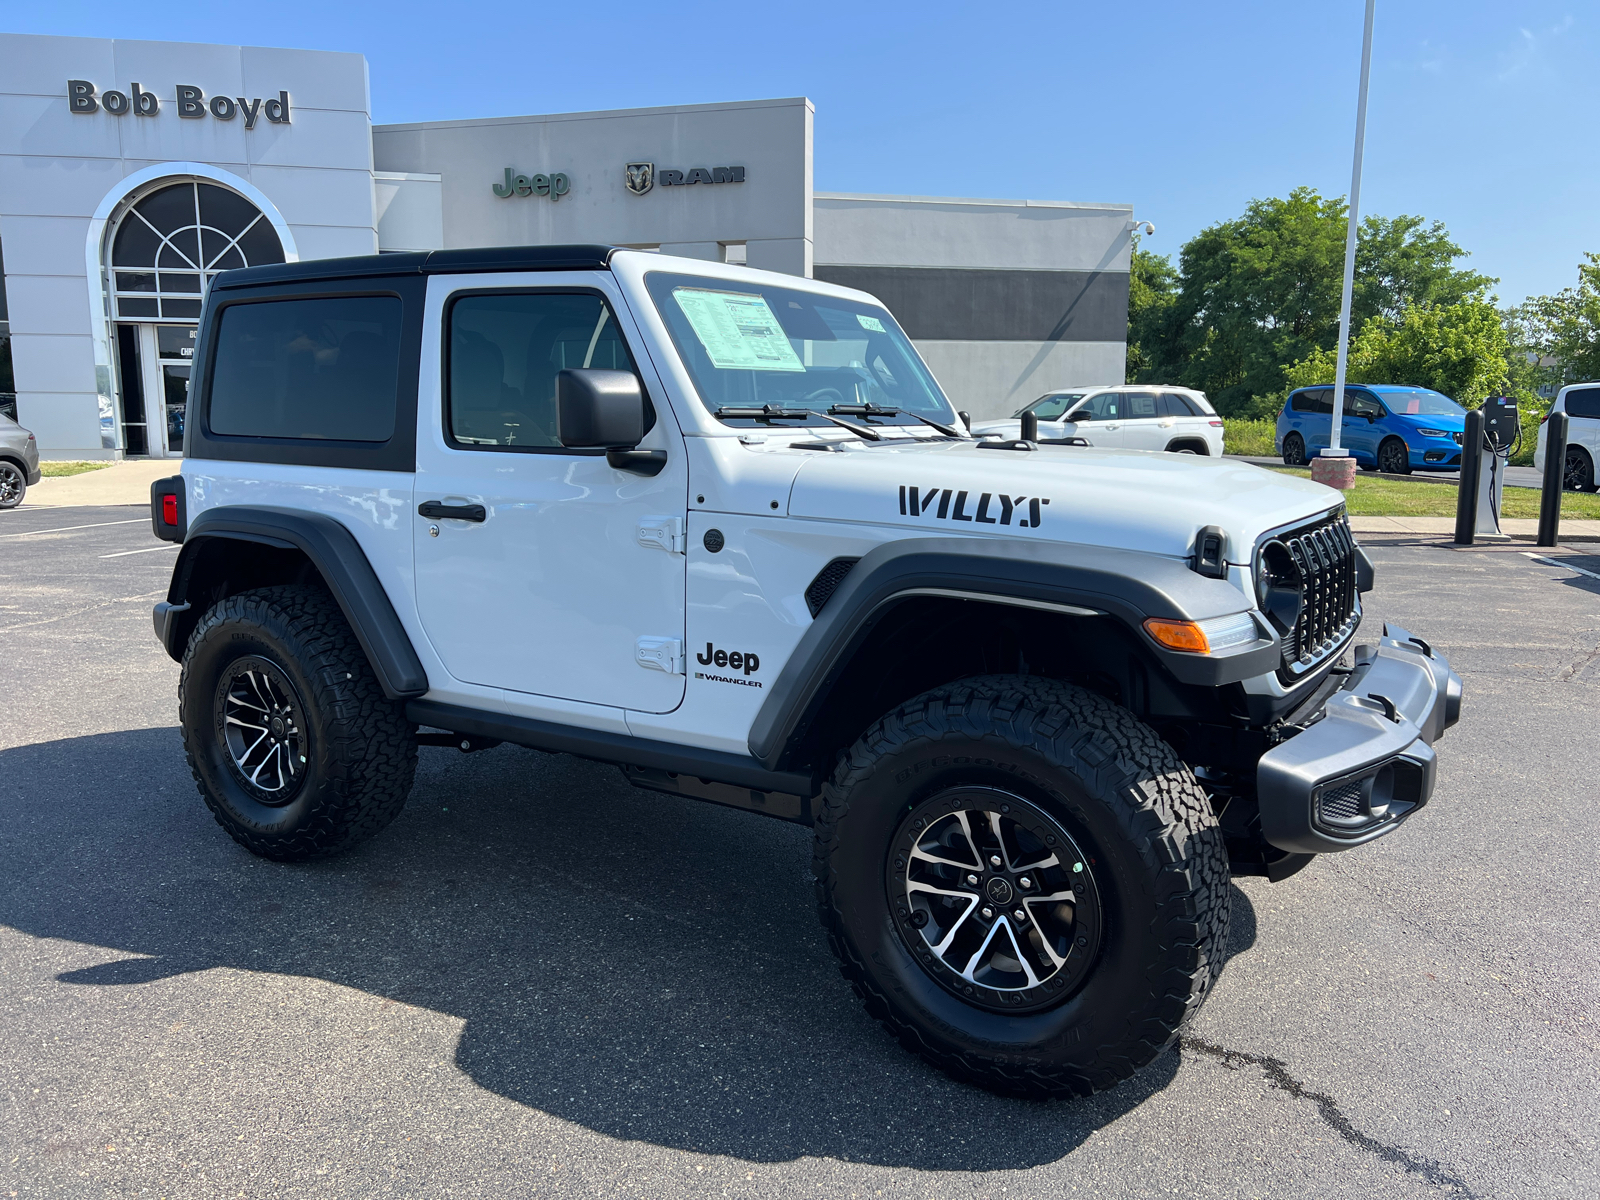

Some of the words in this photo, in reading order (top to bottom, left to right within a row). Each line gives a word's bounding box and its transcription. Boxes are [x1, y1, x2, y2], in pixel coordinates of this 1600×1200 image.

[67, 79, 159, 116] Bob
[175, 84, 291, 129] Boyd
[492, 167, 570, 202] Jeep
[659, 166, 746, 187] RAM
[899, 484, 1051, 528] WILLYS
[696, 641, 760, 676] Jeep
[704, 673, 763, 688] WRANGLER
[893, 755, 1090, 824] BFGoodrich
